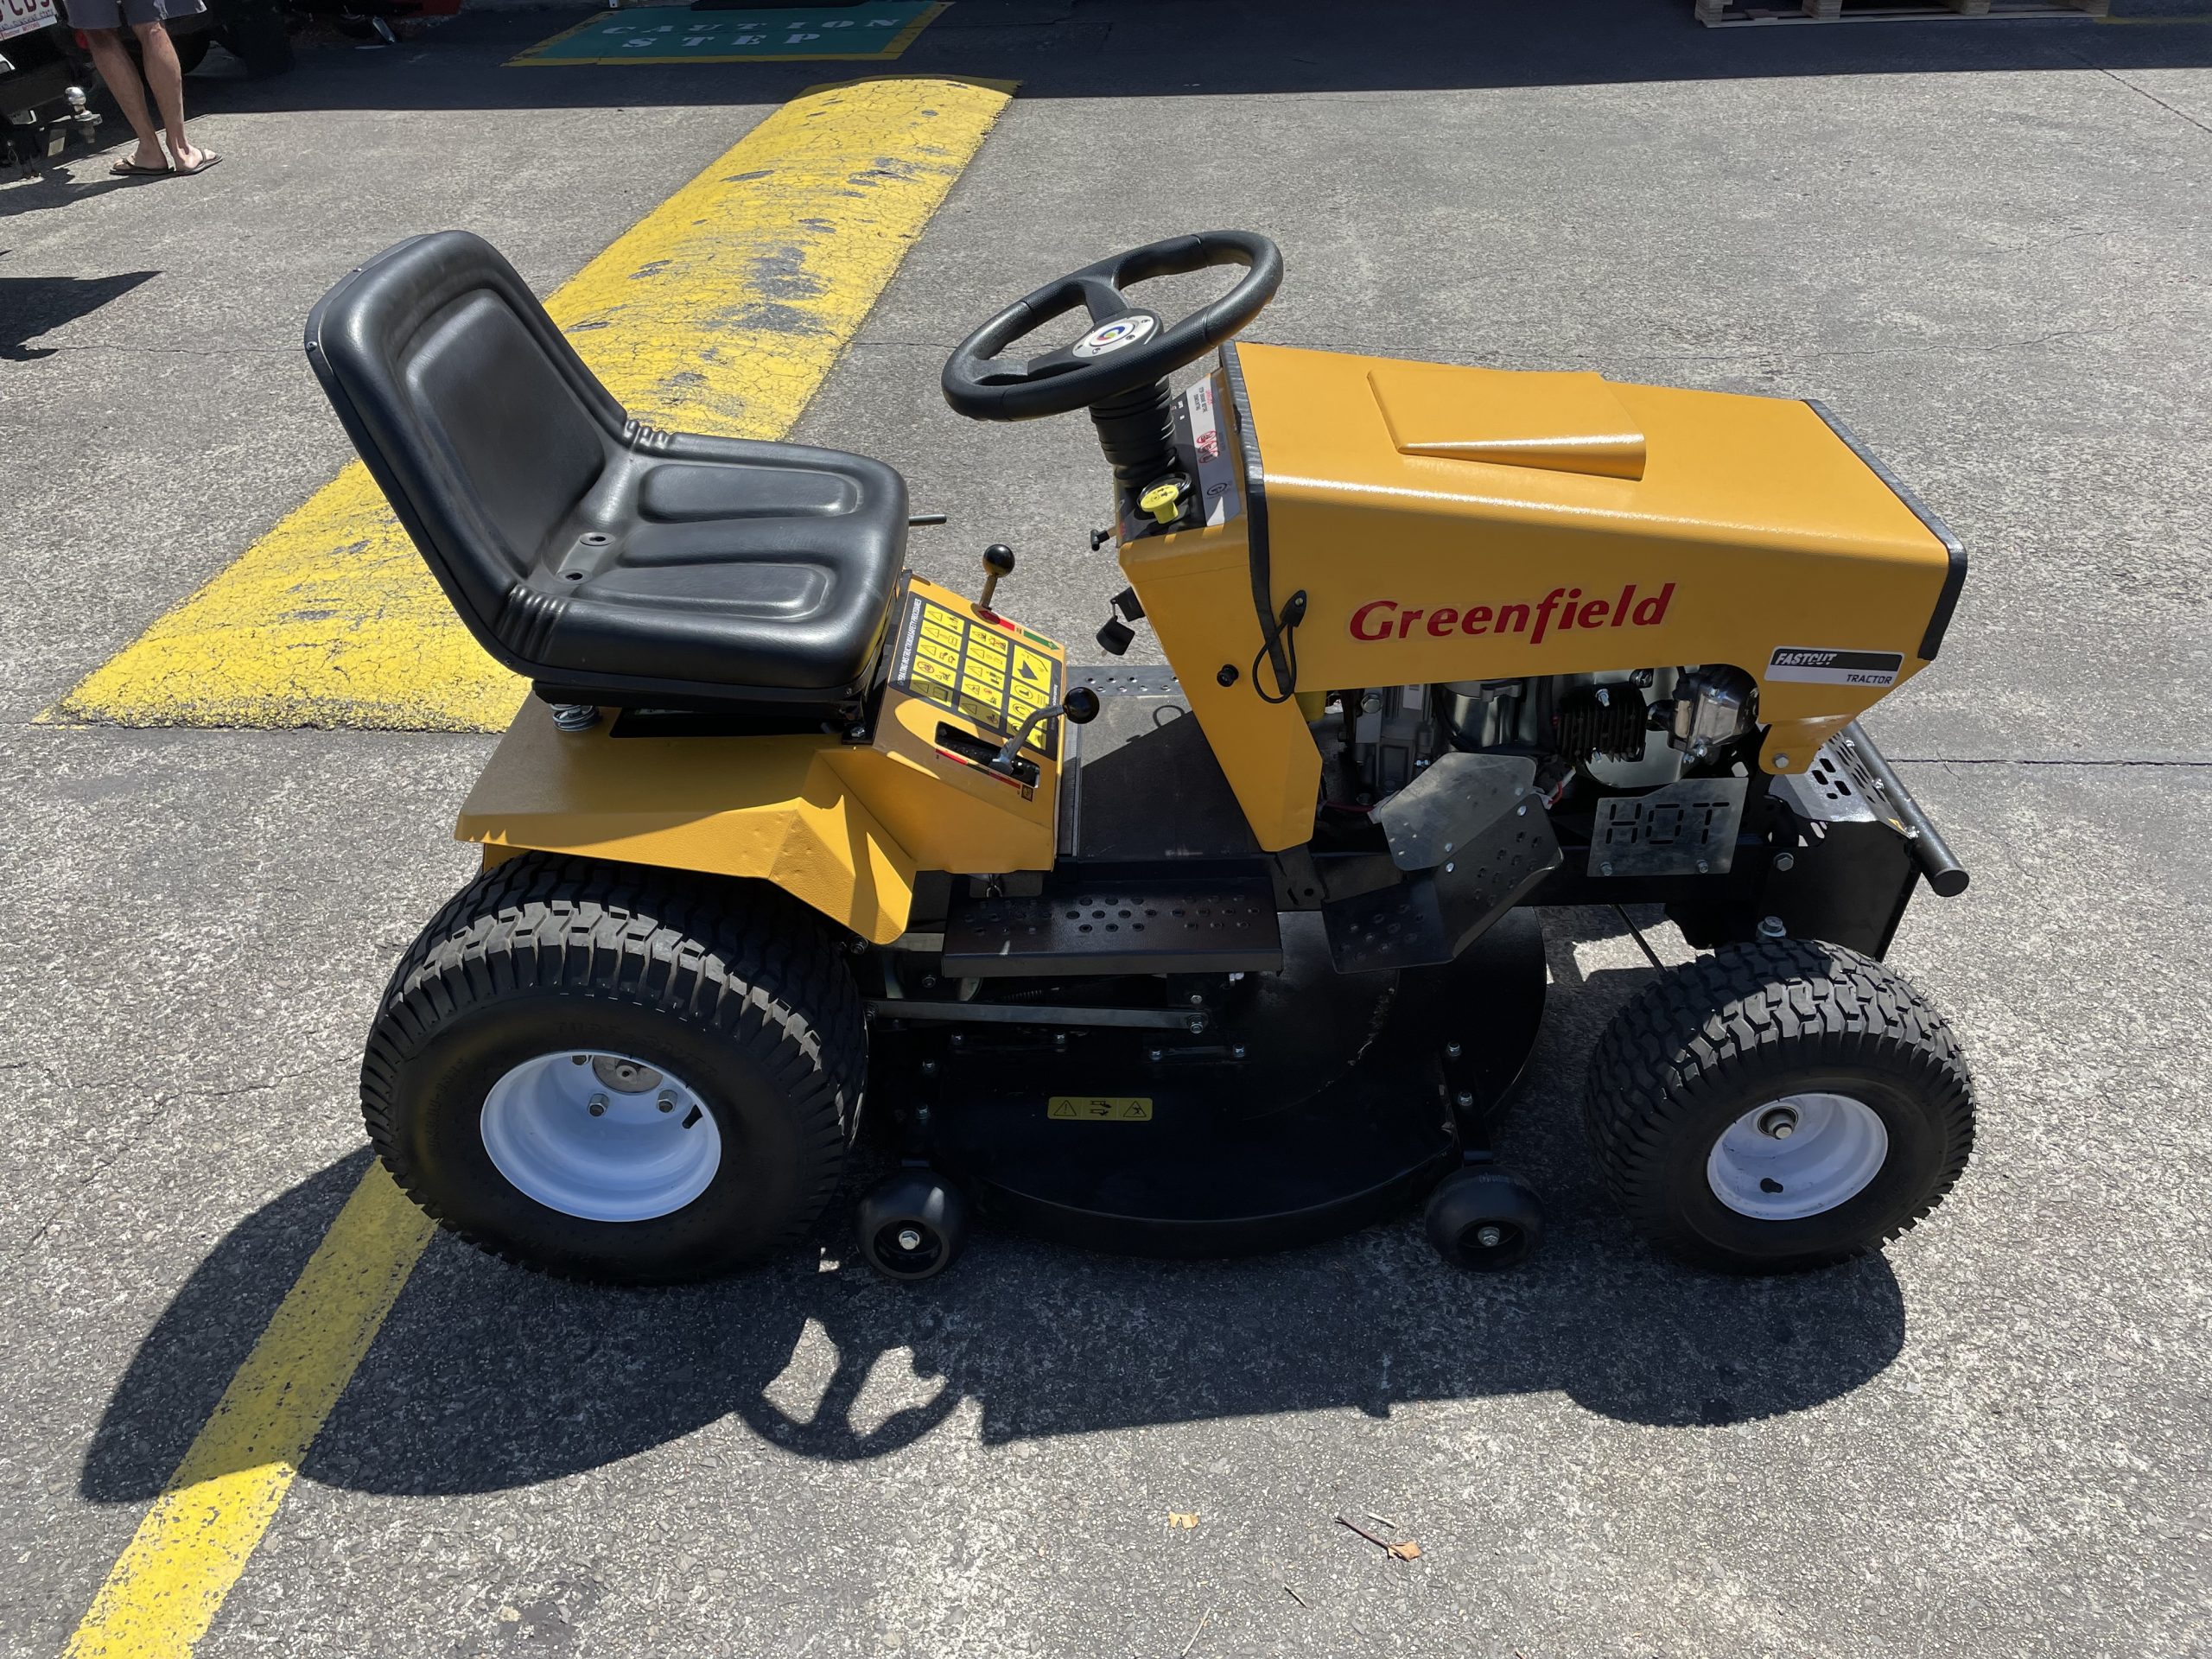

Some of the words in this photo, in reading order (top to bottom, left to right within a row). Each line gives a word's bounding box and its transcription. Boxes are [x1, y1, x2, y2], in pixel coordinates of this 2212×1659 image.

[602, 19, 900, 34] CAUTION
[622, 34, 820, 48] STEP
[1349, 582, 1677, 645] Greenfield
[1775, 653, 1838, 665] FASTCUT
[1847, 674, 1893, 684] TRACTOR
[1605, 802, 1730, 844] HOT
